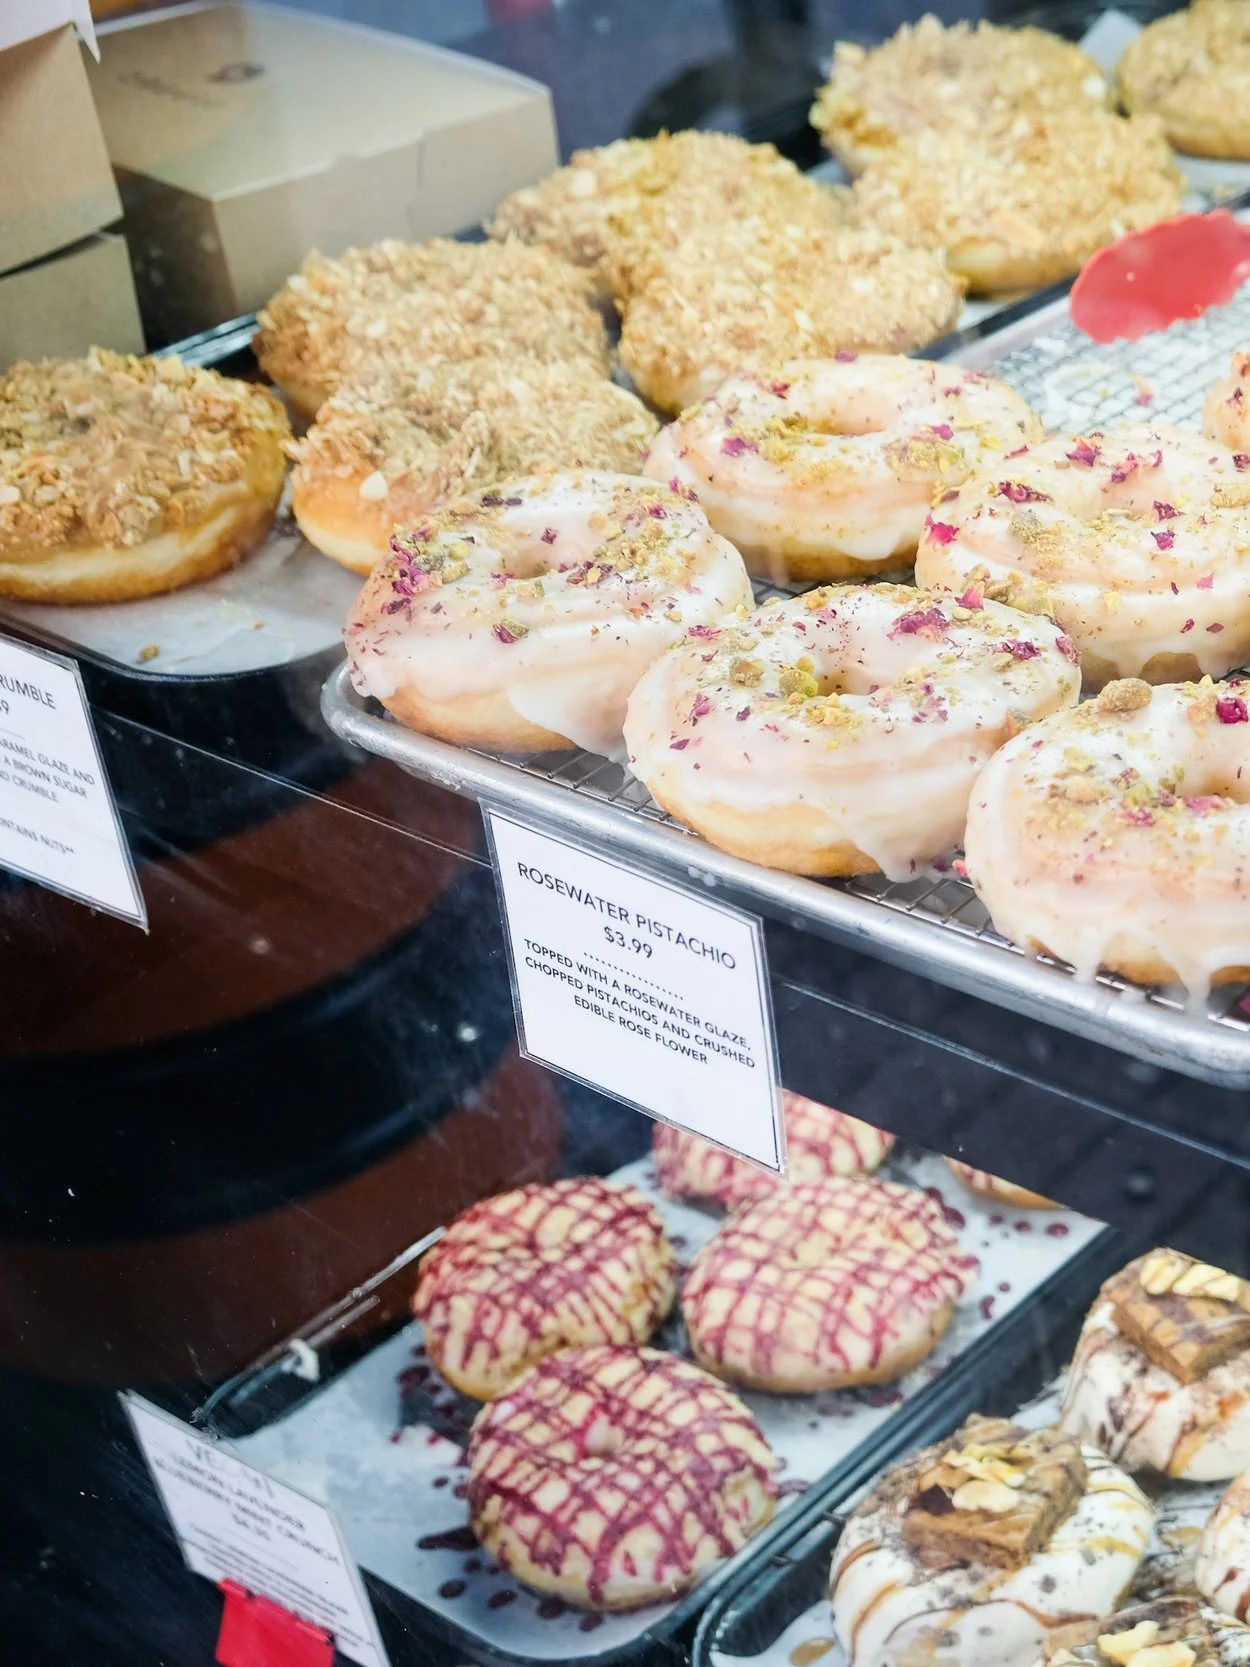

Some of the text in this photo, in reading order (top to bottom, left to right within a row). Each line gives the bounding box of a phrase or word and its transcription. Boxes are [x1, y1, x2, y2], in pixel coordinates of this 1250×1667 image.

[0, 738, 96, 786] RAMEL GLAZE AND
[4, 755, 88, 800] A BROWN SUGAR
[12, 775, 60, 803] CRUMBLE
[517, 861, 737, 970] ROSEWATER PISTACHIO
[603, 925, 653, 959] $3.99
[523, 938, 751, 1051] TOPPED WITH A ROSEWATER GLAZE,
[525, 956, 755, 1068] CHOPPED PISTACHIOS AND CRUSHED
[574, 994, 708, 1065] EDIBLE ROSE FLOWER
